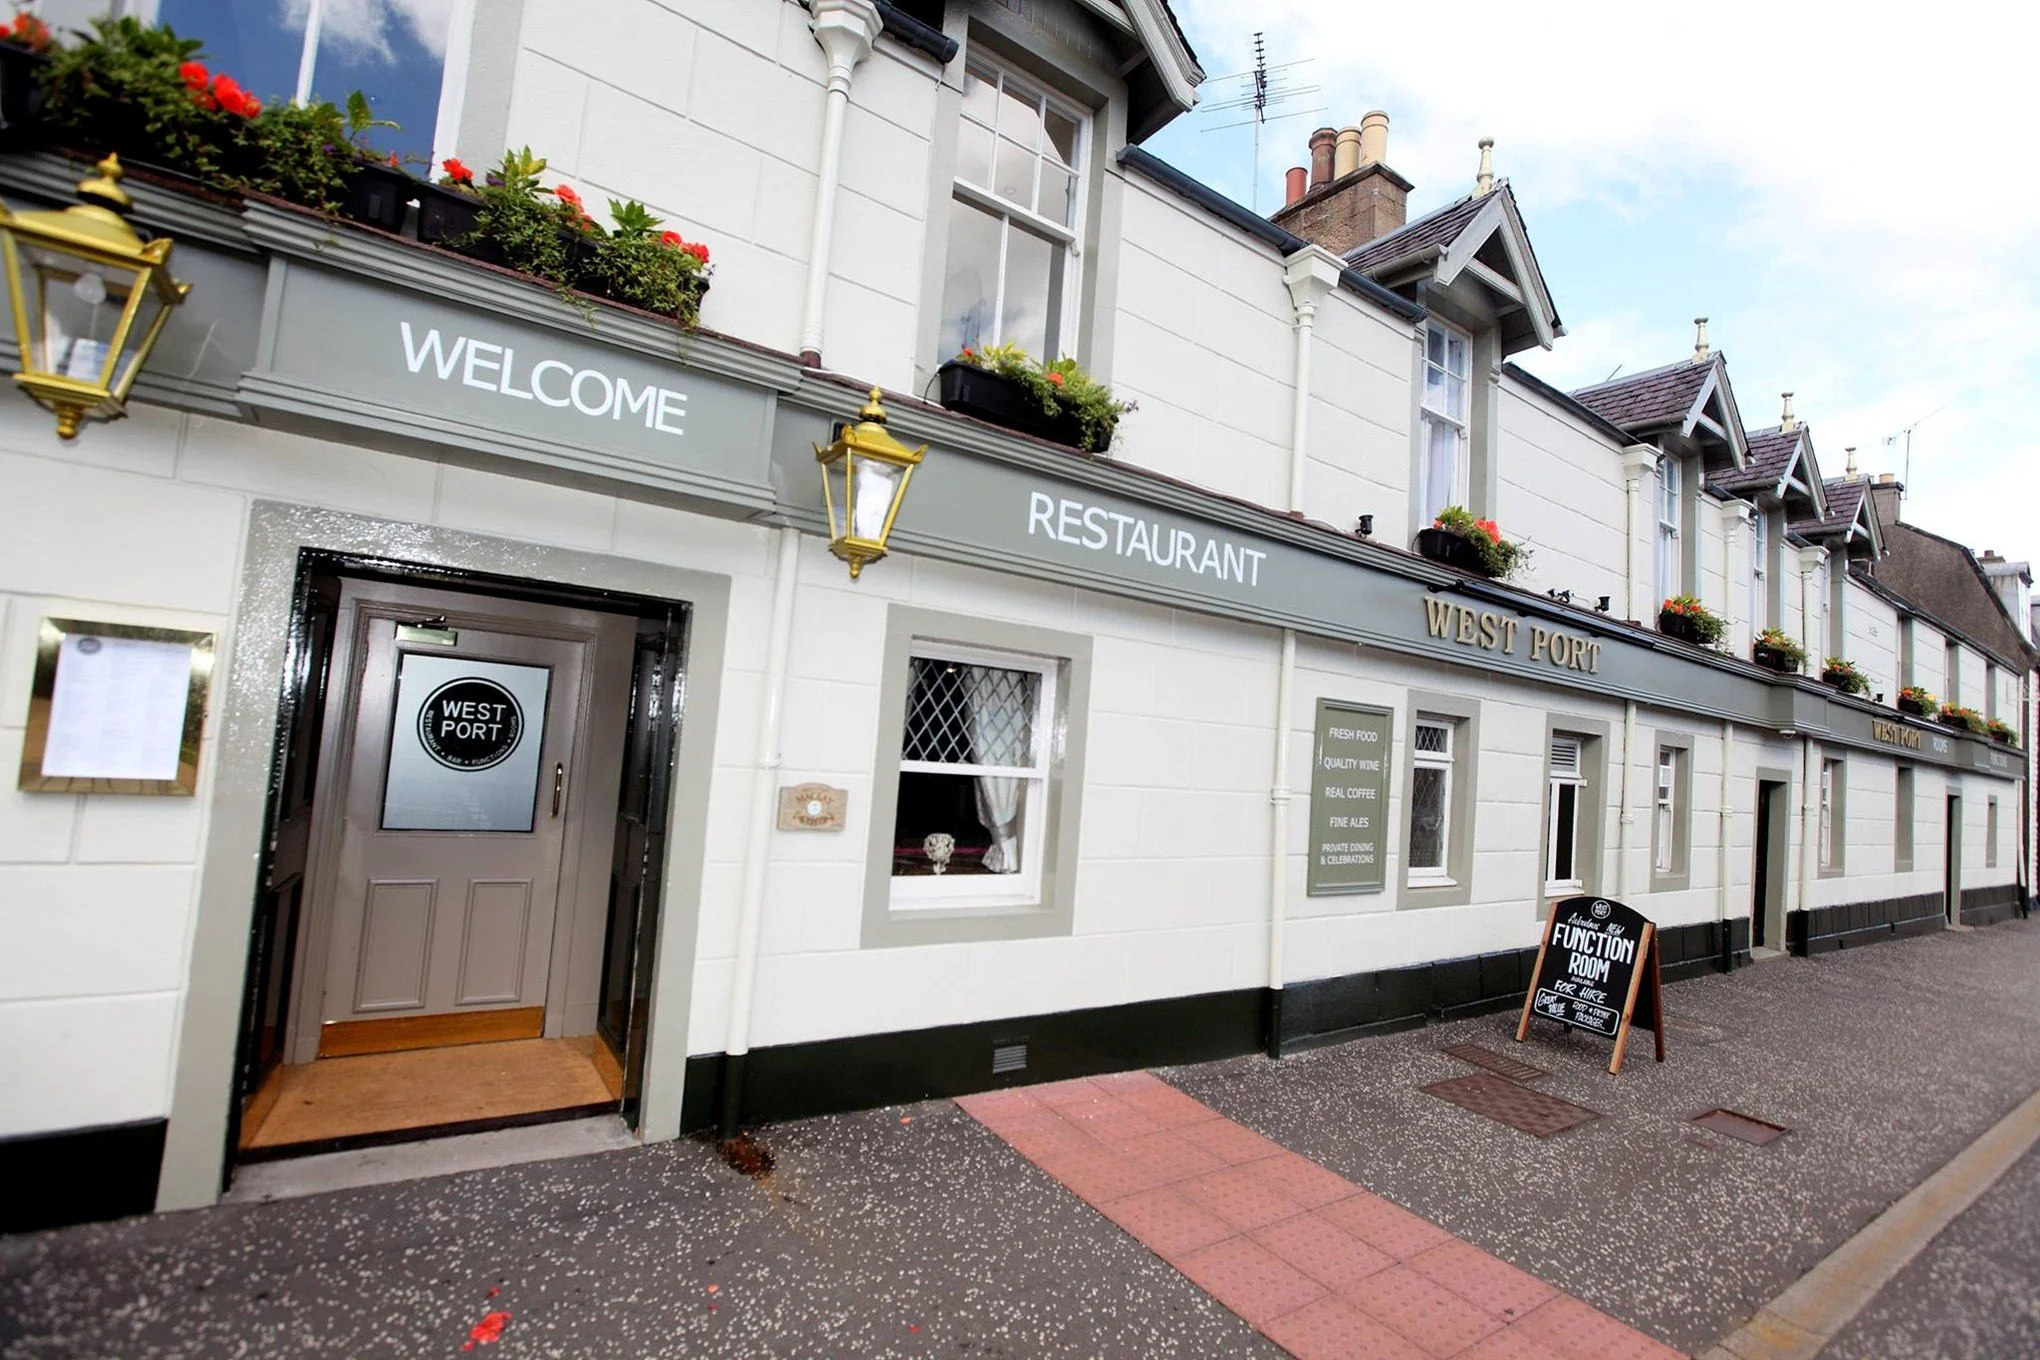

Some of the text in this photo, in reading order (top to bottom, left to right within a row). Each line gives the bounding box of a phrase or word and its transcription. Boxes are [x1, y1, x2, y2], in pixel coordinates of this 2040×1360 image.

[400, 321, 688, 436] WELCOME
[1027, 491, 1266, 586] RESTAURANT
[1424, 596, 1602, 674] WEST PORT
[442, 700, 507, 722] WEST
[441, 720, 502, 741] PORT
[1329, 727, 1378, 742] FRESH FOOD
[1872, 718, 1899, 745] WEST
[471, 744, 509, 765] FUNCTIONS
[1323, 757, 1380, 771] QUALITY WINE
[1325, 787, 1376, 799] REAL COFFEE
[1330, 816, 1369, 828] FINE ALES
[1322, 843, 1374, 852] PRIVATE DINING
[1327, 854, 1374, 865] CELEBRATIONS
[1605, 923, 1625, 936] NEW
[1552, 922, 1635, 965] FUNCTION
[1567, 952, 1611, 983] ROOM
[1554, 979, 1608, 1004] FOR HIRE
